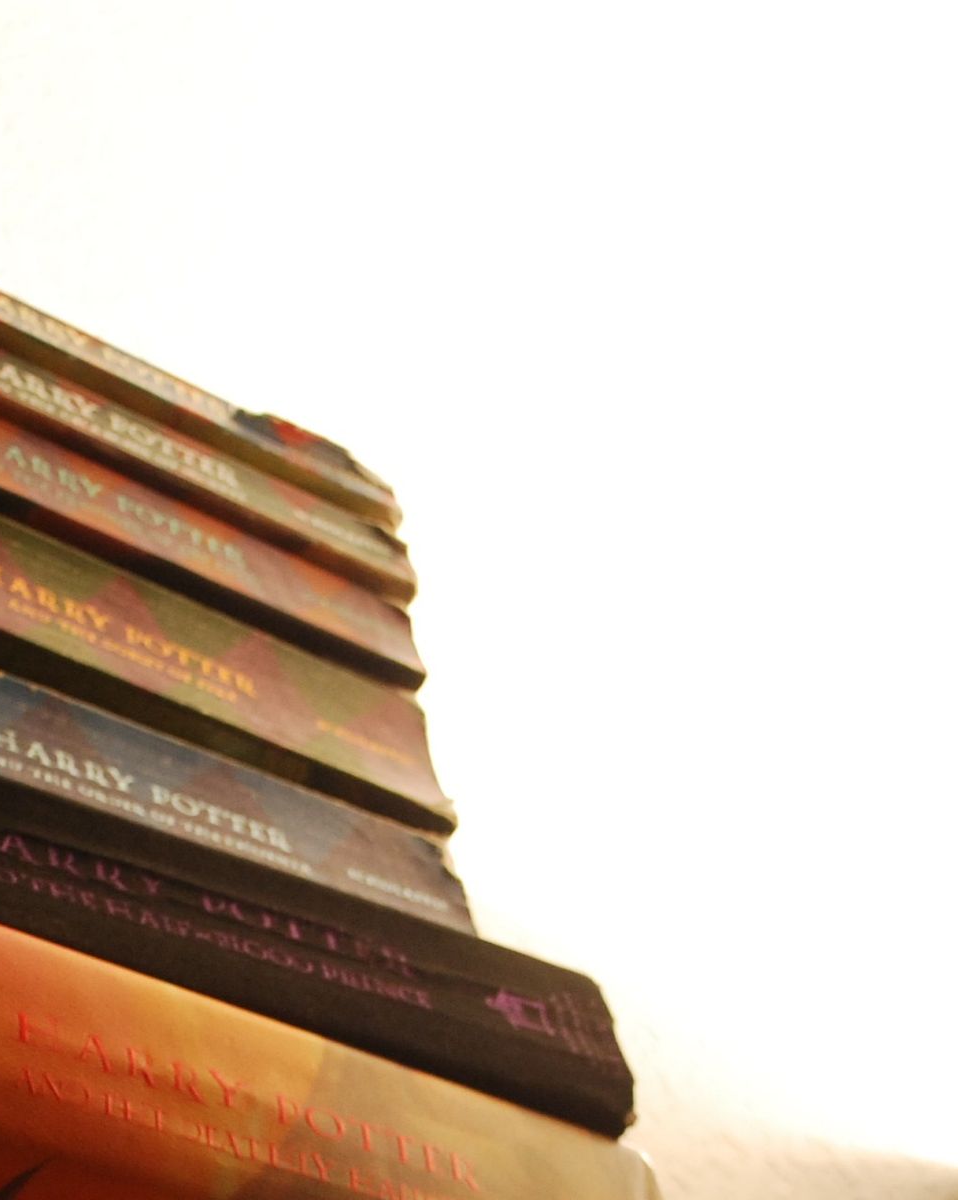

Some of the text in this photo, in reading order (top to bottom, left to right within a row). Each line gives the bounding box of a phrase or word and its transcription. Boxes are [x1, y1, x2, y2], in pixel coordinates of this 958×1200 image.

[110, 412, 239, 490] POTTER
[124, 624, 258, 699] POTTER
[150, 784, 292, 855] POTTER
[17, 1011, 249, 1107] HARRY
[276, 1094, 480, 1193] POTTER
